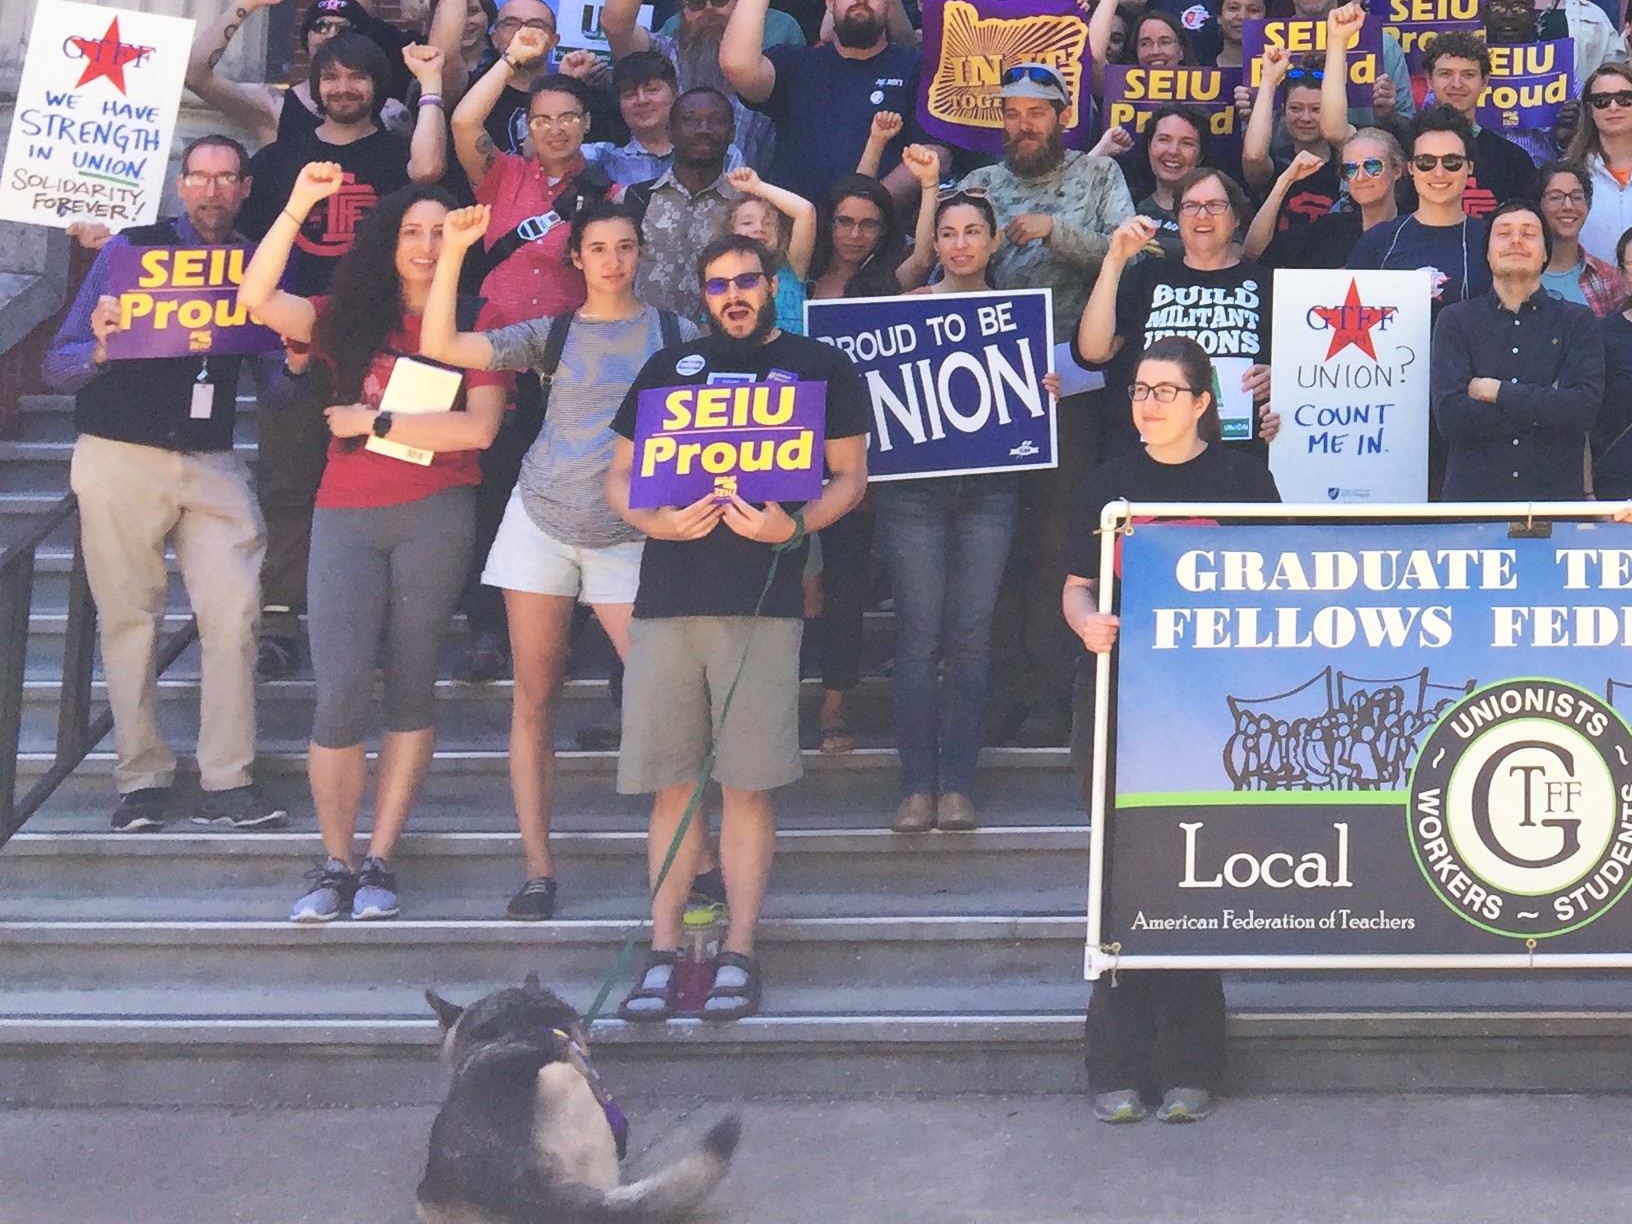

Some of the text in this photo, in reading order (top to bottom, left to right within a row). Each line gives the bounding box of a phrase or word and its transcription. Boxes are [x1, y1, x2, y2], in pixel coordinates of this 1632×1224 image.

[62, 34, 157, 69] GTFF
[1263, 20, 1361, 52] SEI
[1382, 26, 1487, 54] Pro
[951, 54, 1004, 88] IN
[1490, 43, 1556, 76] EIU
[1123, 68, 1222, 101] SEIU
[1476, 73, 1568, 109] roud
[45, 90, 161, 124] WE HAVE
[1110, 103, 1235, 136] Prd
[20, 108, 161, 155] STRENGTH
[28, 144, 54, 161] IN
[11, 167, 145, 207] SOLIDARITY
[32, 192, 147, 222] FOREVER!
[119, 293, 270, 331] Prou
[1151, 283, 1261, 309] BUILD
[925, 313, 967, 347] TO
[976, 301, 1018, 337] BE
[1144, 304, 1260, 330] MILITANT
[1305, 304, 1400, 331] GTFF
[1143, 329, 1261, 355] ONS
[1297, 345, 1416, 389] UNION?
[662, 385, 797, 432] SEIU
[860, 337, 1046, 453] NION
[1294, 403, 1396, 427] COUNT
[640, 430, 815, 478] Proud
[1308, 431, 1349, 454] ME
[1175, 549, 1518, 593] GRADUATE
[1151, 605, 1454, 650] FELLOWS
[1450, 687, 1609, 740] UNIONISTS
[1178, 821, 1354, 889] Local
[1417, 788, 1504, 921] WORKERS
[1130, 908, 1417, 931] American Federation of Teachers
